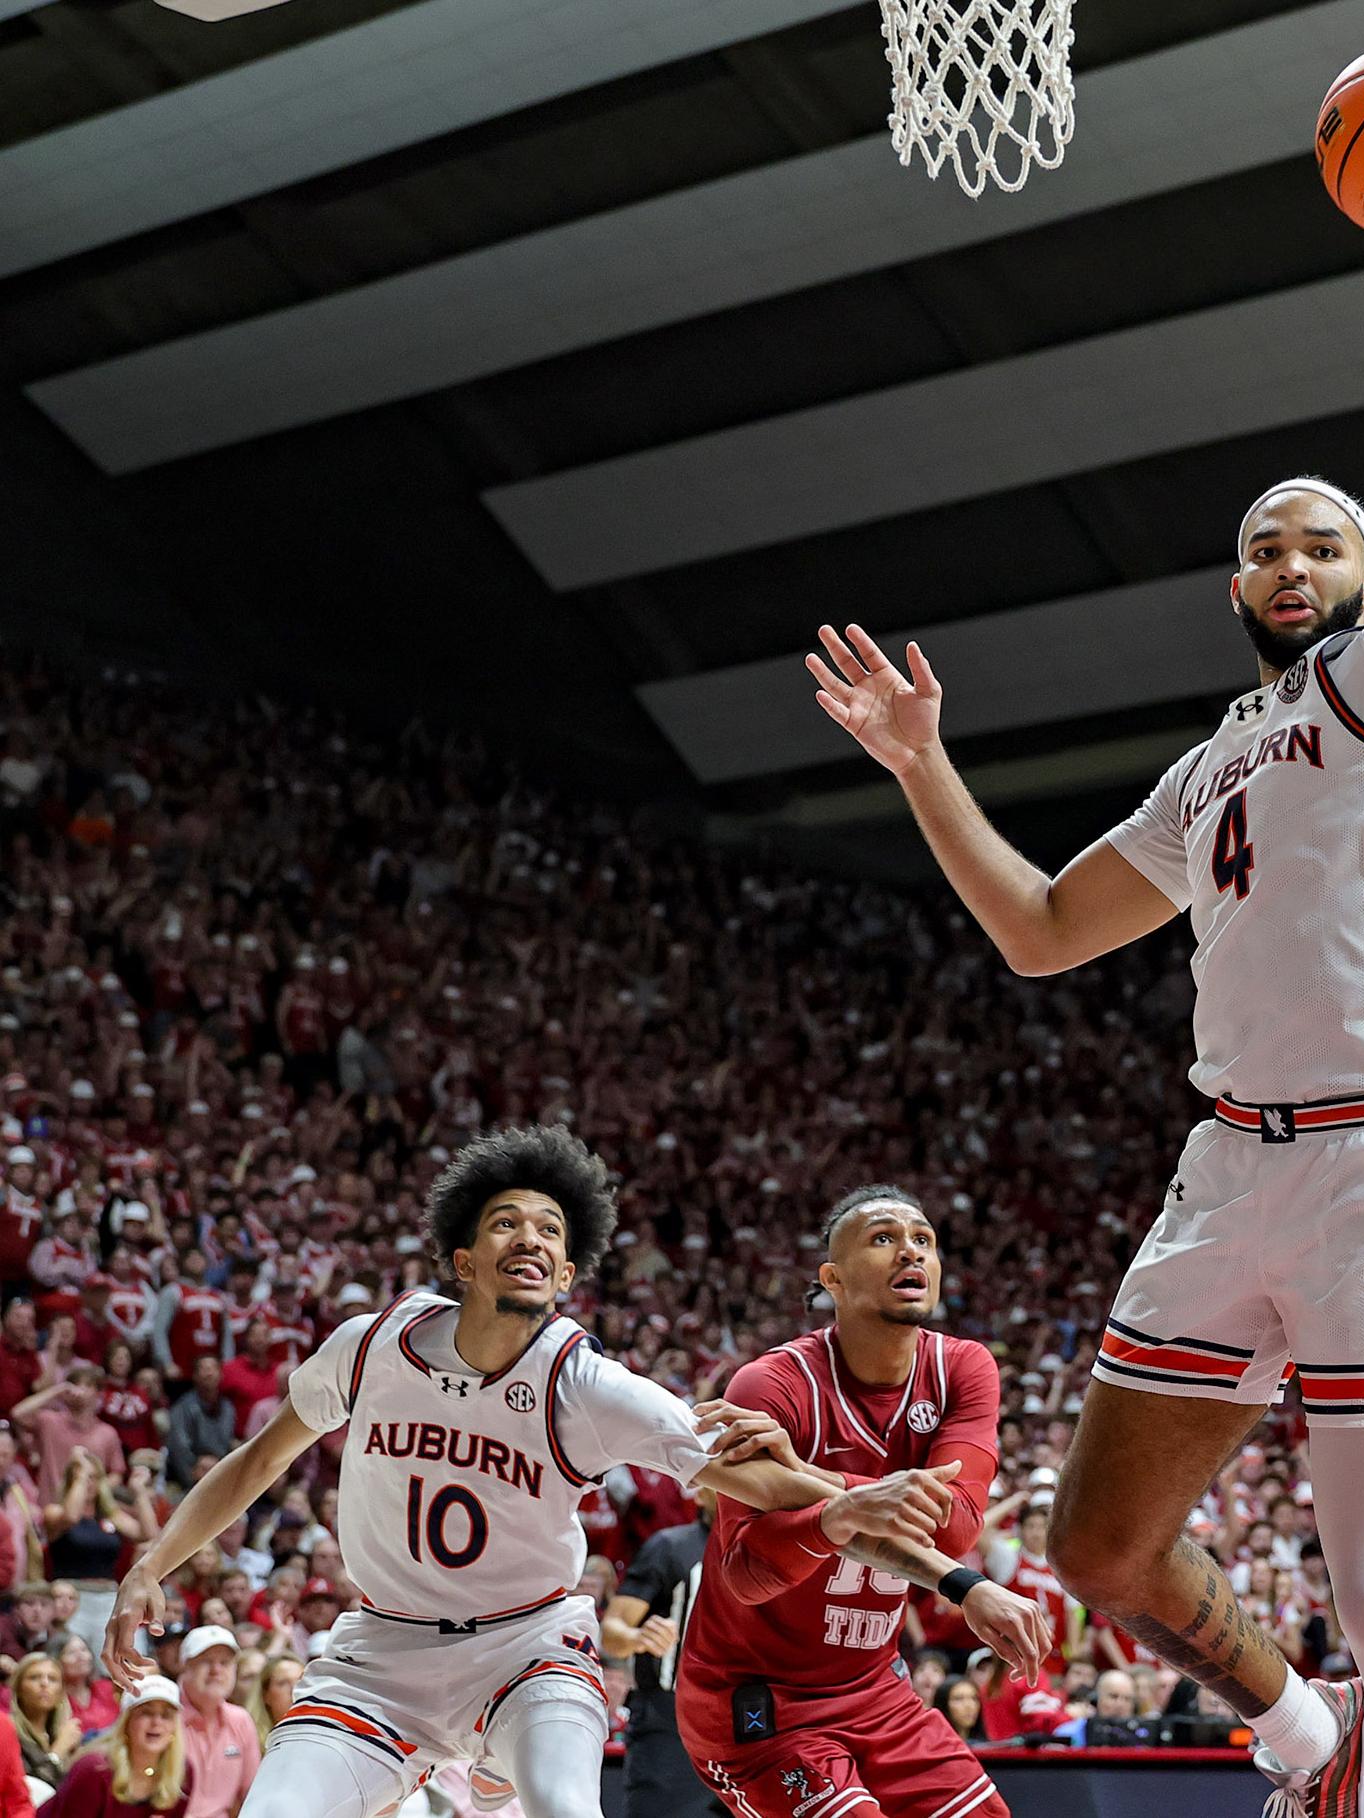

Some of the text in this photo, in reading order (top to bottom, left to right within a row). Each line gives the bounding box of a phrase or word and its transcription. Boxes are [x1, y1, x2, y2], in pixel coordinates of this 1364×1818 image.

[1182, 723, 1325, 833] AUBURN
[1211, 786, 1255, 901] 4
[506, 1384, 536, 1412] SEC
[909, 1402, 938, 1431] SEC
[364, 1422, 545, 1499] AUBURN
[407, 1474, 489, 1569] 10
